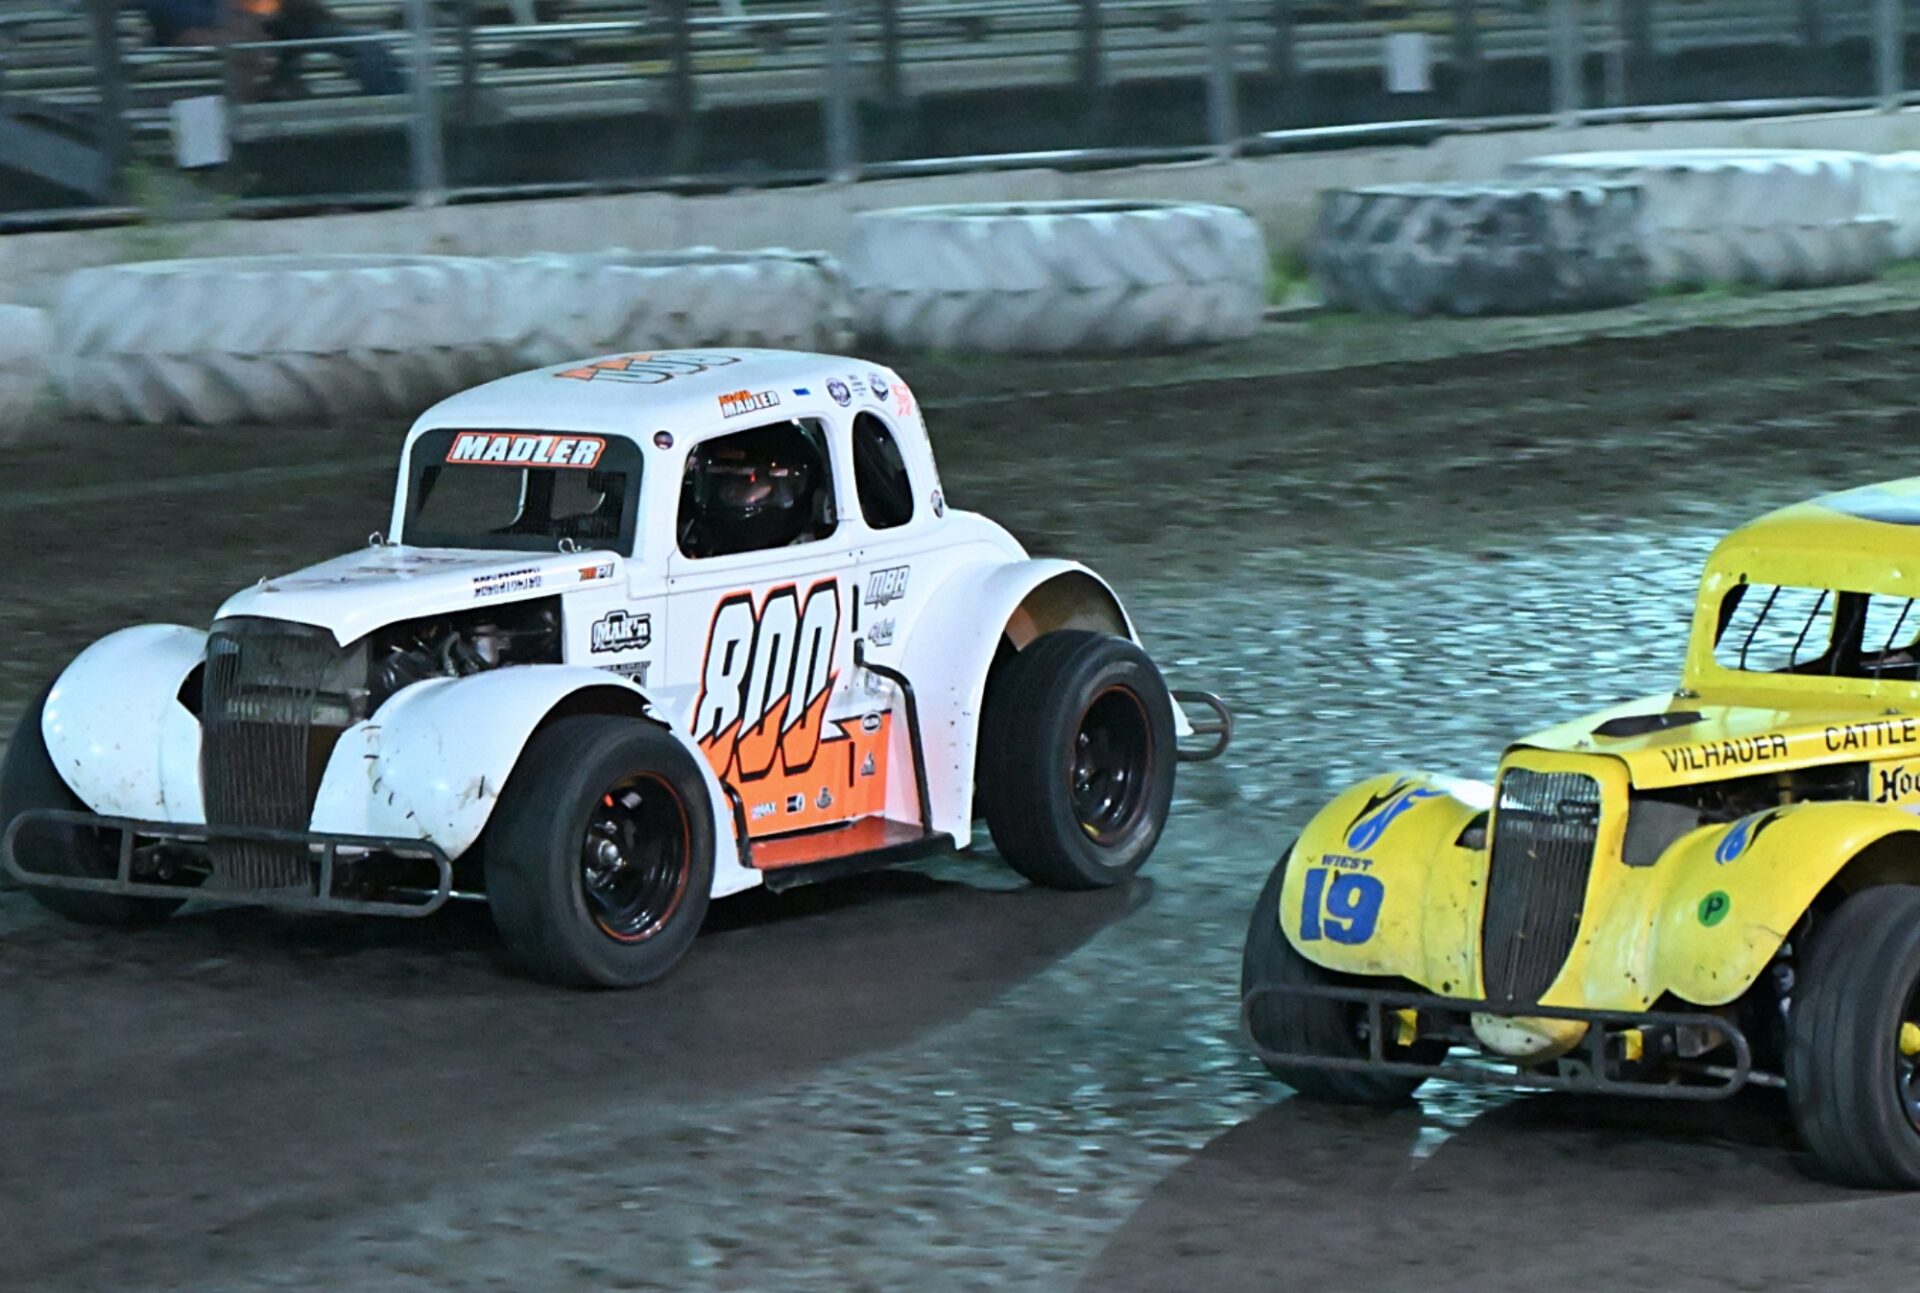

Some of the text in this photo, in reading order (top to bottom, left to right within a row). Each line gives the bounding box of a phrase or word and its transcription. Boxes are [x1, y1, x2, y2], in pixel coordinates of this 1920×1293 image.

[451, 435, 601, 465] MADLER
[690, 576, 841, 783] 800
[1662, 718, 1917, 773] VILHAUER CATTLE
[1300, 867, 1385, 946] 19
